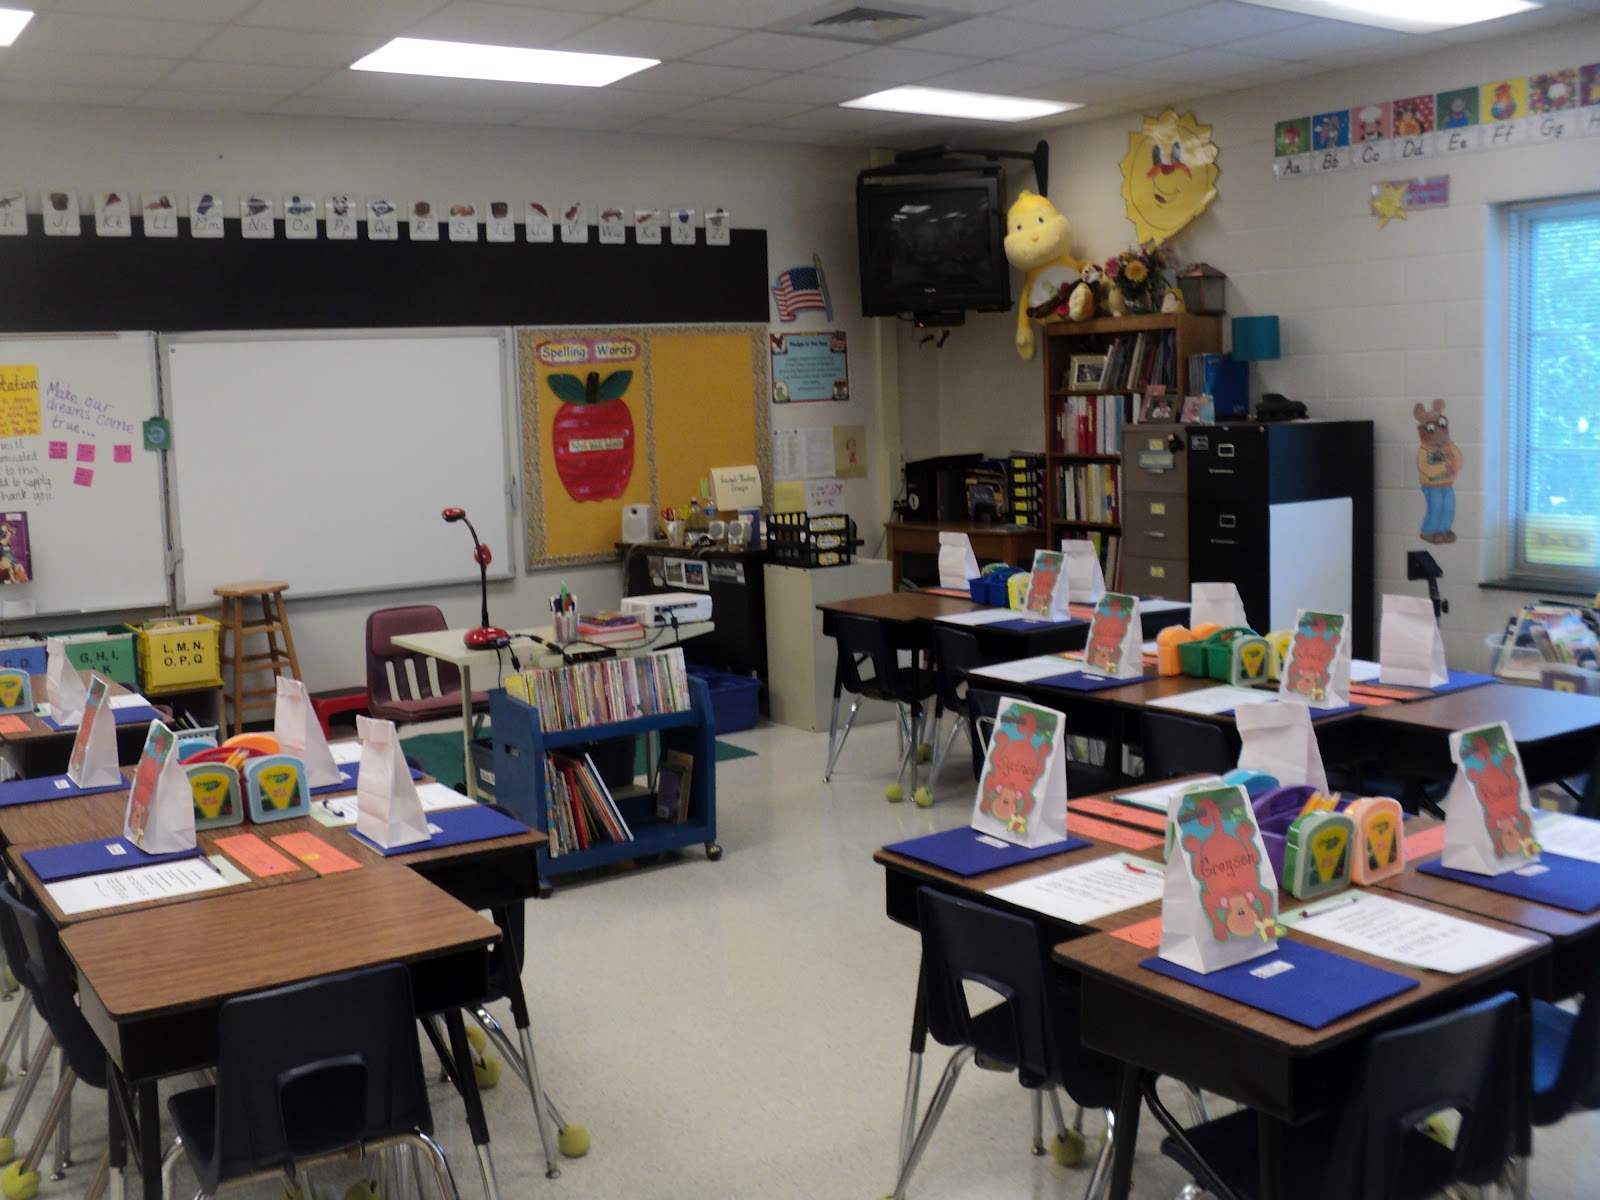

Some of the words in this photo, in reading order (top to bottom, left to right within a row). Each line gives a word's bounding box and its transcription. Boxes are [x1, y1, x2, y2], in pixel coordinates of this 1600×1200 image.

[1283, 159, 1302, 175] Aa
[1321, 153, 1340, 170] Bb
[1361, 147, 1381, 163] Cc
[1402, 140, 1424, 157] Dd
[1447, 133, 1467, 150] Ee
[1491, 125, 1514, 144] Ff
[1540, 118, 1564, 139] Gg
[542, 345, 586, 360] Spelling
[597, 343, 633, 356] Words
[46, 381, 78, 404] Make
[46, 398, 91, 420] dreams
[103, 664, 112, 674] K
[193, 653, 203, 664] Q
[1200, 852, 1256, 878] Grayson
